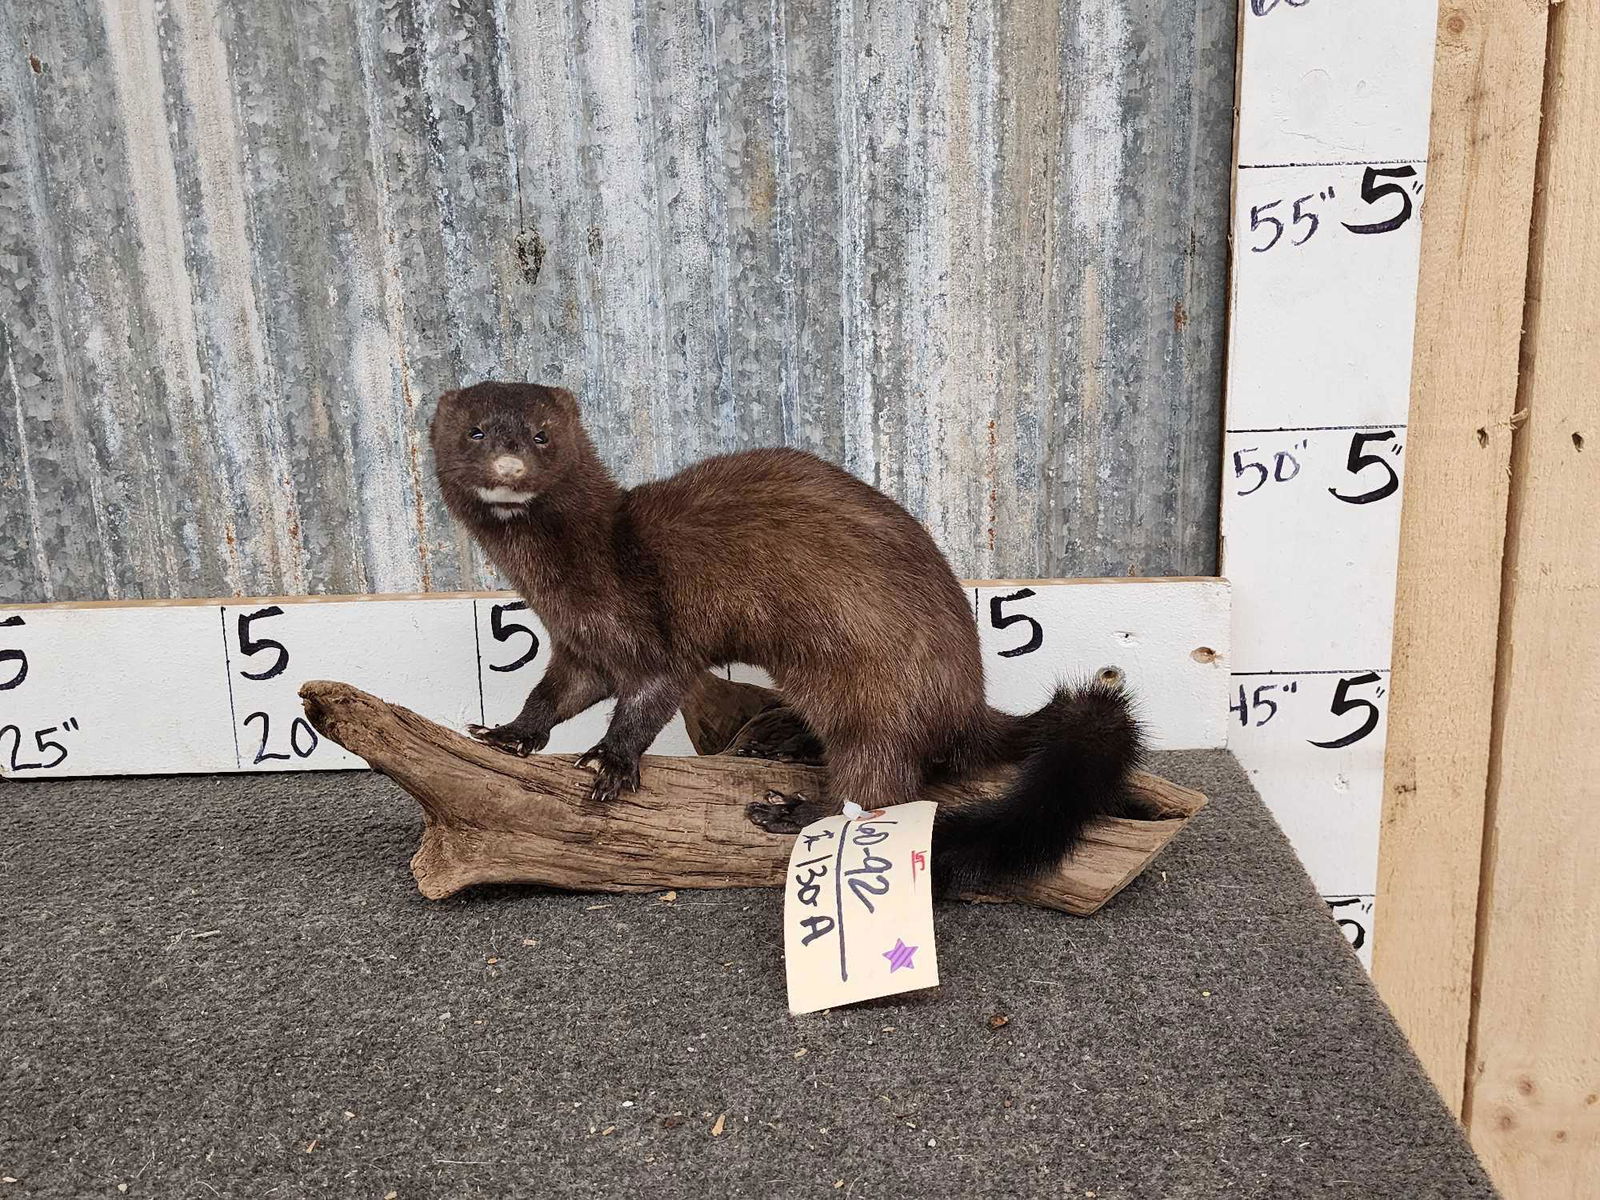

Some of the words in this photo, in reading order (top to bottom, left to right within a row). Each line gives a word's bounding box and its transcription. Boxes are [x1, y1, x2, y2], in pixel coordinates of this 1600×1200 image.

[1249, 186, 1336, 253] 55"
[1232, 438, 1308, 496] 50"
[237, 606, 290, 681] 5
[488, 600, 540, 673] 5
[989, 588, 1044, 658] 5
[1228, 680, 1298, 727] 45"
[0, 716, 80, 771] 25"
[243, 711, 319, 766] 20
